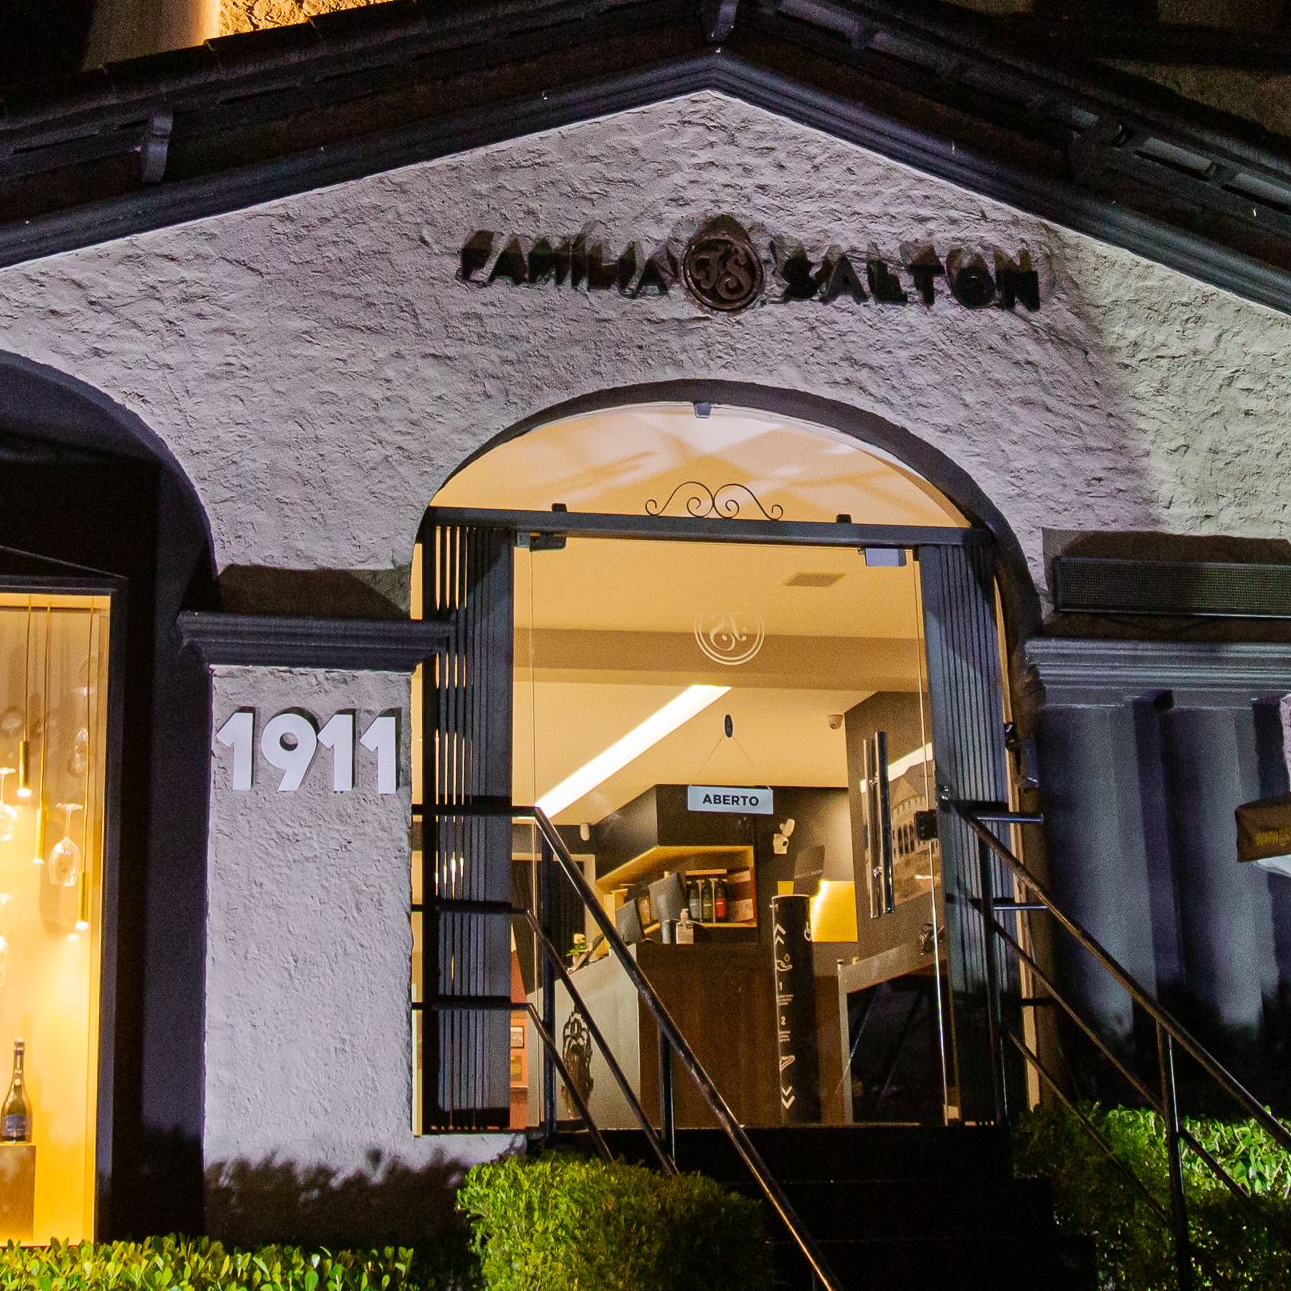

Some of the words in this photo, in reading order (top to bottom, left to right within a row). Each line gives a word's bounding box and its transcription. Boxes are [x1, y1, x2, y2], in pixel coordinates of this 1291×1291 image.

[781, 243, 1041, 311] SALTON
[216, 711, 397, 795] 1911
[702, 793, 760, 807] ABERTO
